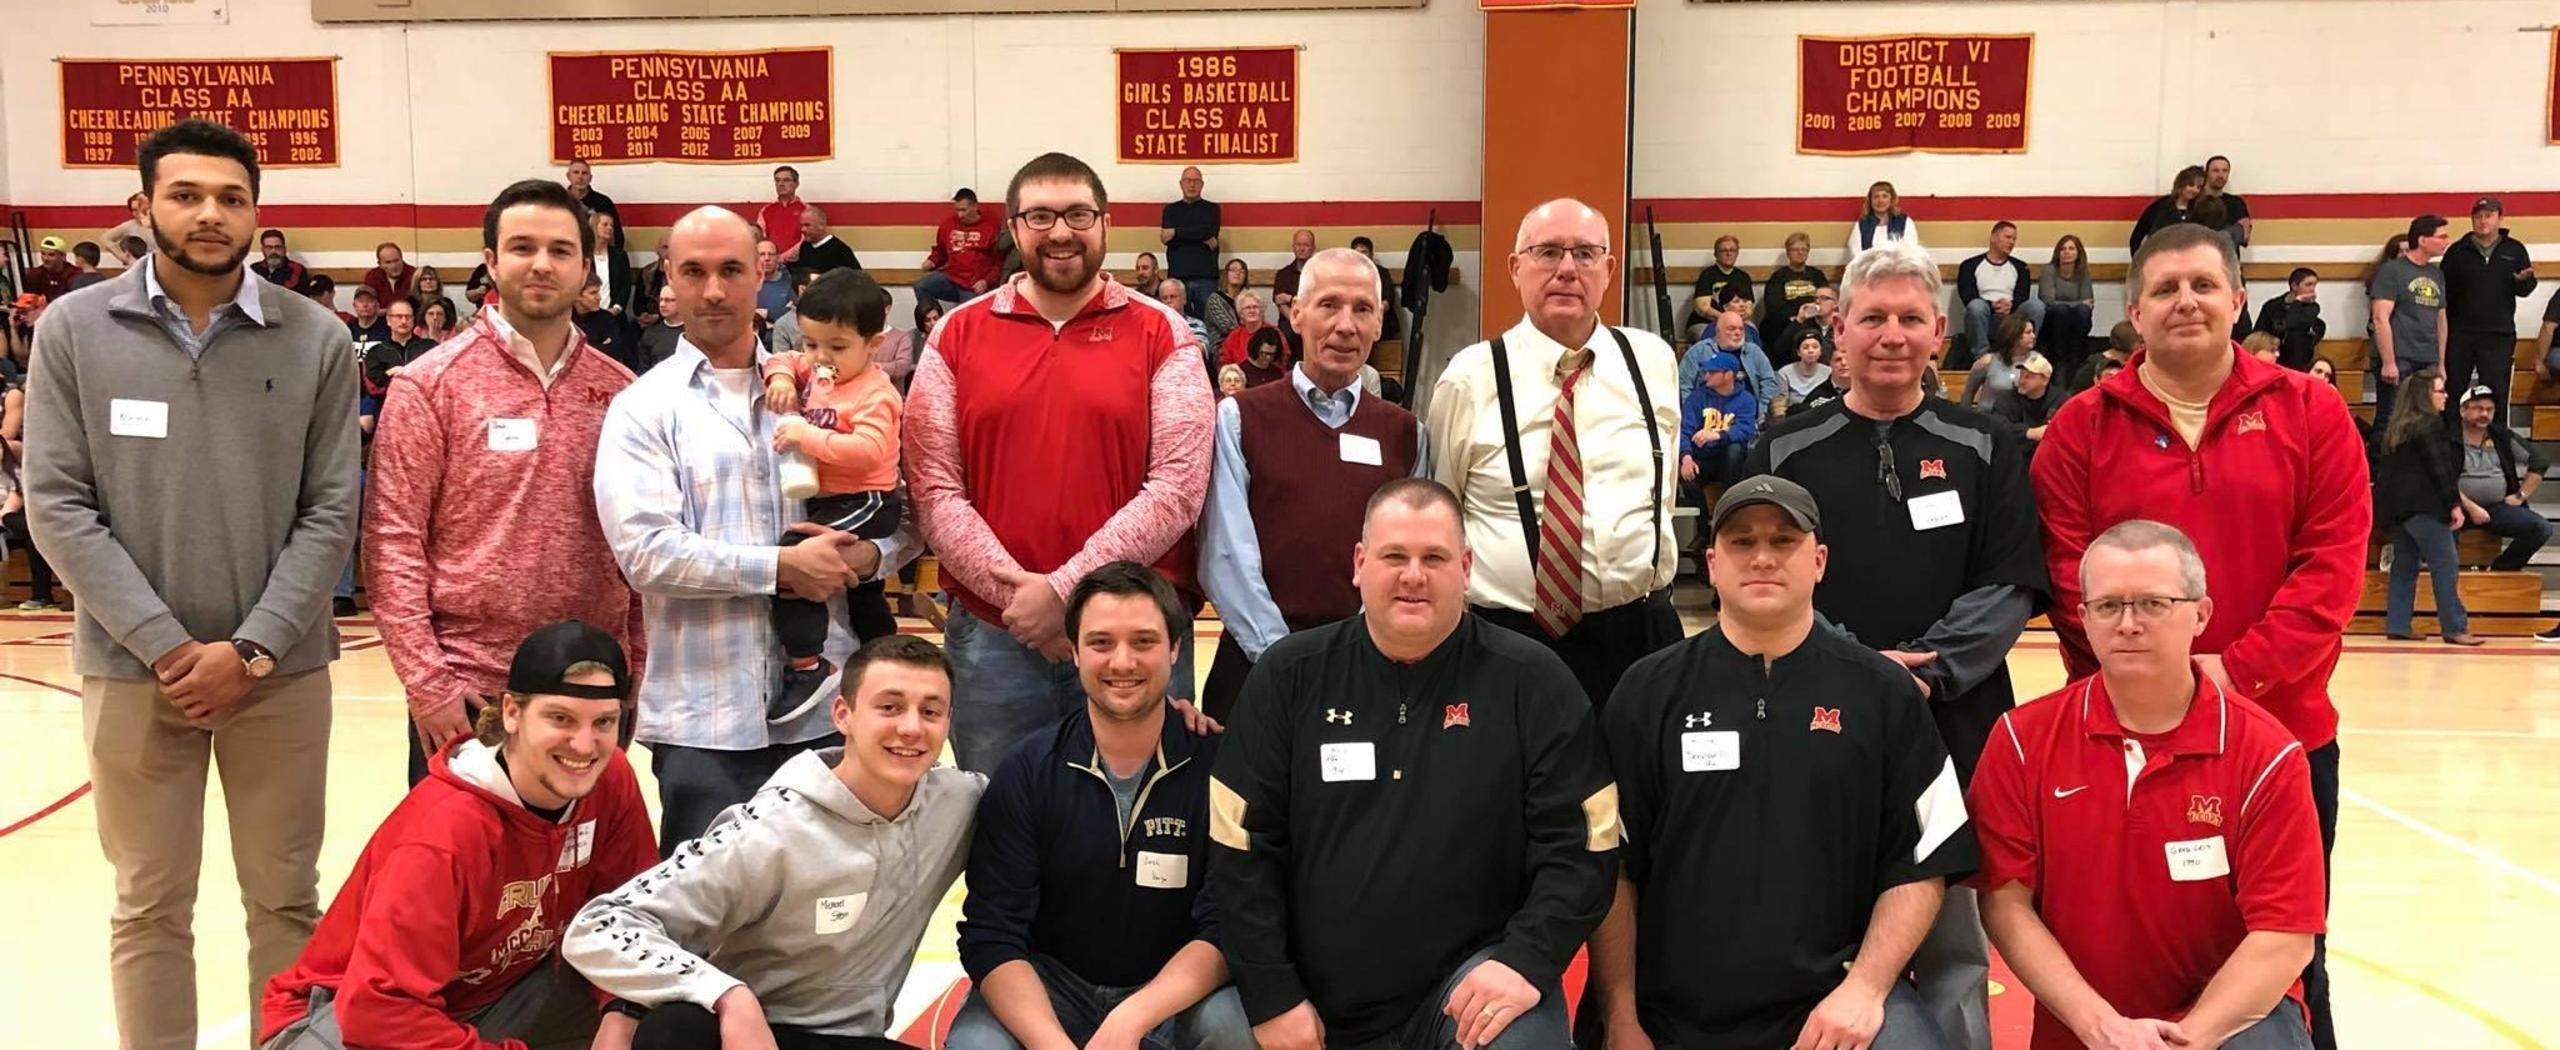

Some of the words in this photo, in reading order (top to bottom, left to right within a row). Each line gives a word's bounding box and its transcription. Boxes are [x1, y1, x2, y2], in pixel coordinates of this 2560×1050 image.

[1840, 40, 1949, 66] DISTRICT
[1968, 40, 1990, 63] VI
[119, 65, 275, 87] PENNSYLVANIA
[610, 57, 769, 80] PENNSYLVANIA
[1177, 56, 1237, 78] 1986
[1850, 64, 1976, 90] FOOTBALL
[141, 88, 212, 109] CLASS
[225, 88, 254, 108] AA
[634, 79, 706, 101] CLASS
[720, 81, 748, 101] AA
[1124, 83, 1171, 104] GIRLS
[1184, 81, 1291, 104] BASKETBALL
[1846, 88, 1981, 113] CHAMPIONS
[69, 109, 176, 130] CHEERLEADING
[248, 109, 330, 130] CHAMPIONS
[558, 104, 669, 125] CHEERLEADING
[682, 104, 727, 124] STATE
[739, 101, 824, 123] CHAMPIONS
[1146, 108, 1223, 130] CLASS
[1238, 107, 1268, 129] AA
[1805, 113, 1836, 129] 2001
[1848, 115, 1882, 131] 2006
[1895, 112, 1926, 127] 2007
[1939, 113, 1973, 128] 2008
[1986, 113, 2021, 129] 2009
[289, 132, 319, 145] 1996
[572, 127, 603, 142] 2003
[626, 126, 659, 140] 2004
[681, 126, 710, 140] 2005
[733, 126, 763, 141] 2007
[781, 125, 810, 138] 2009
[1135, 134, 1187, 154] STATE
[1204, 133, 1279, 154] FINALIST
[84, 148, 113, 161] 1997
[291, 148, 322, 161] 2002
[574, 144, 602, 157] 2010
[627, 142, 654, 156] 2011
[681, 143, 709, 156] 2012
[734, 143, 762, 157] 2013
[587, 386, 610, 406] M
